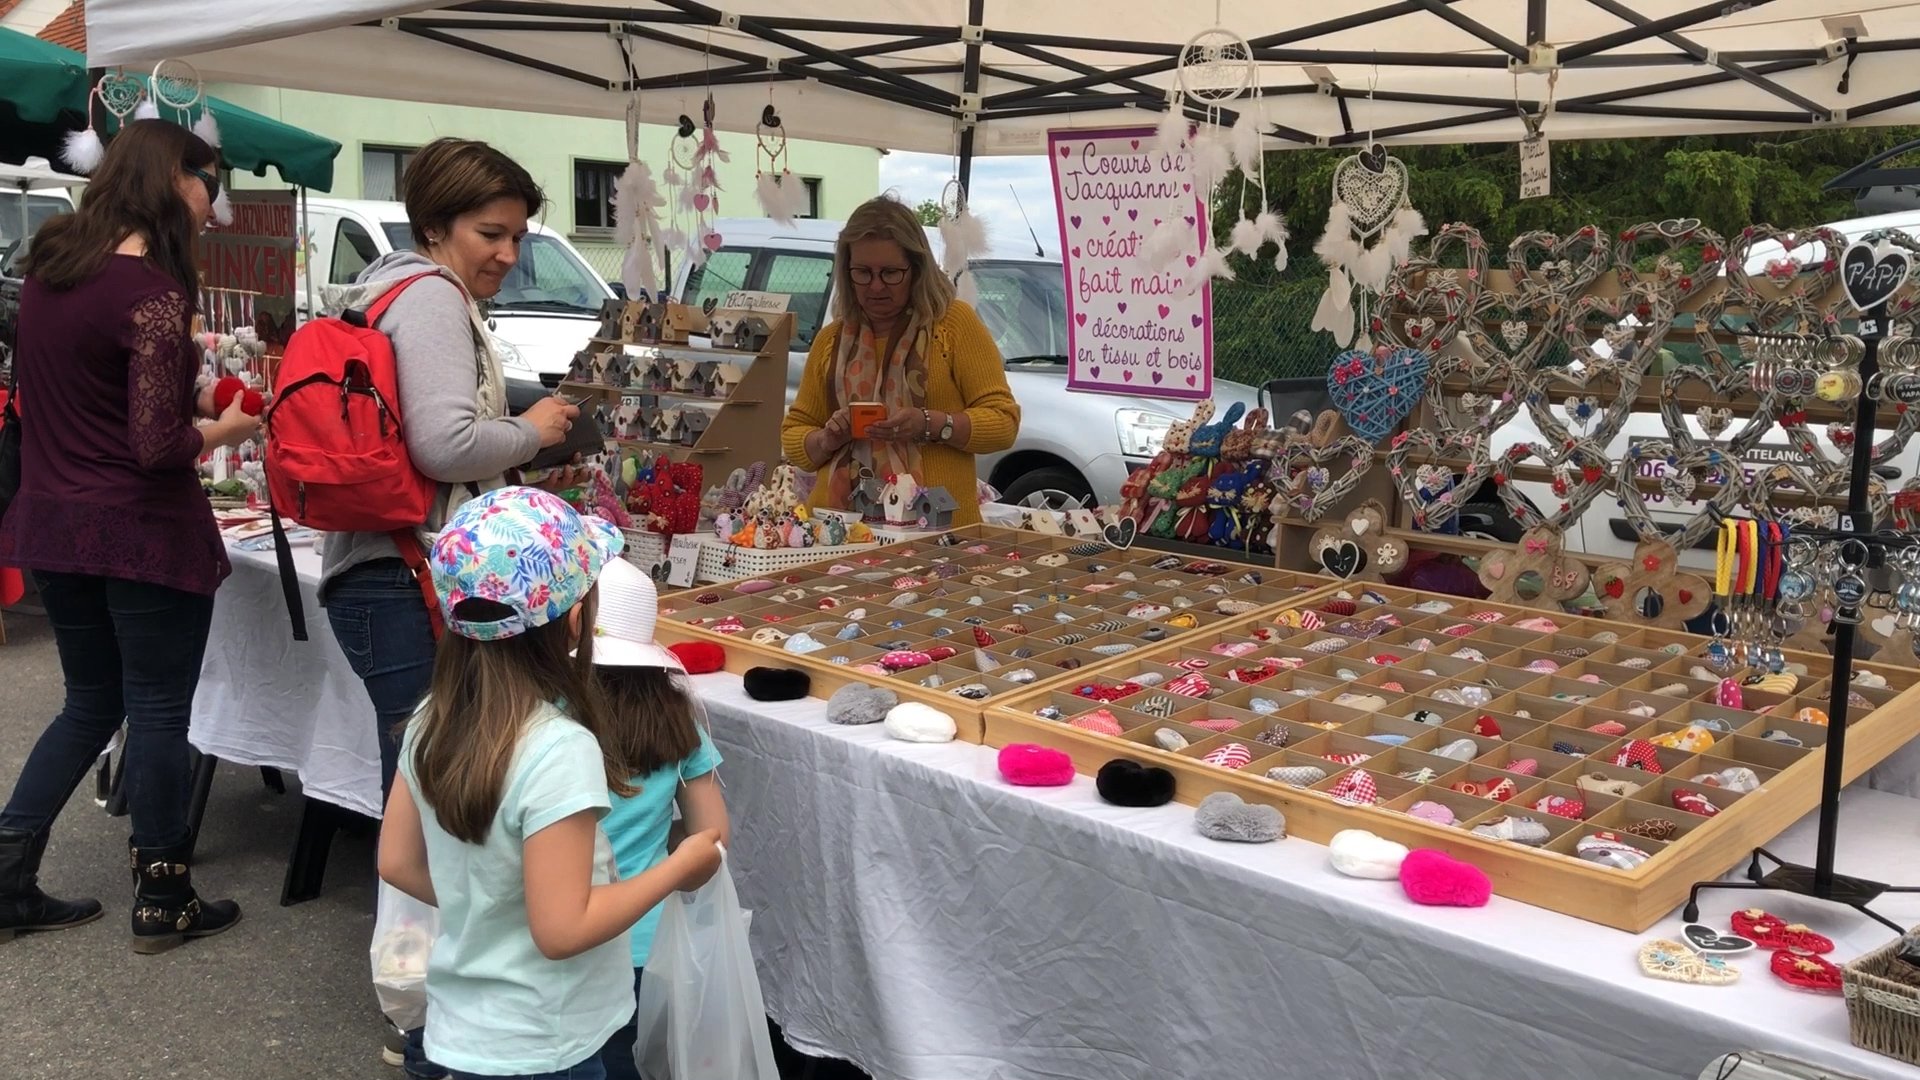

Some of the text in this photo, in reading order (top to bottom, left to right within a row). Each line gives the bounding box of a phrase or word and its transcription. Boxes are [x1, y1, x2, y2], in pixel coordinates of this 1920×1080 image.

[1082, 141, 1152, 176] Coeurs
[200, 242, 295, 296] HINKEN
[1848, 261, 1906, 291] PAPA
[1079, 266, 1188, 303] fait main
[1091, 316, 1186, 343] décorations
[1077, 343, 1202, 371] en tissu et bois
[1640, 461, 1666, 478] 06
